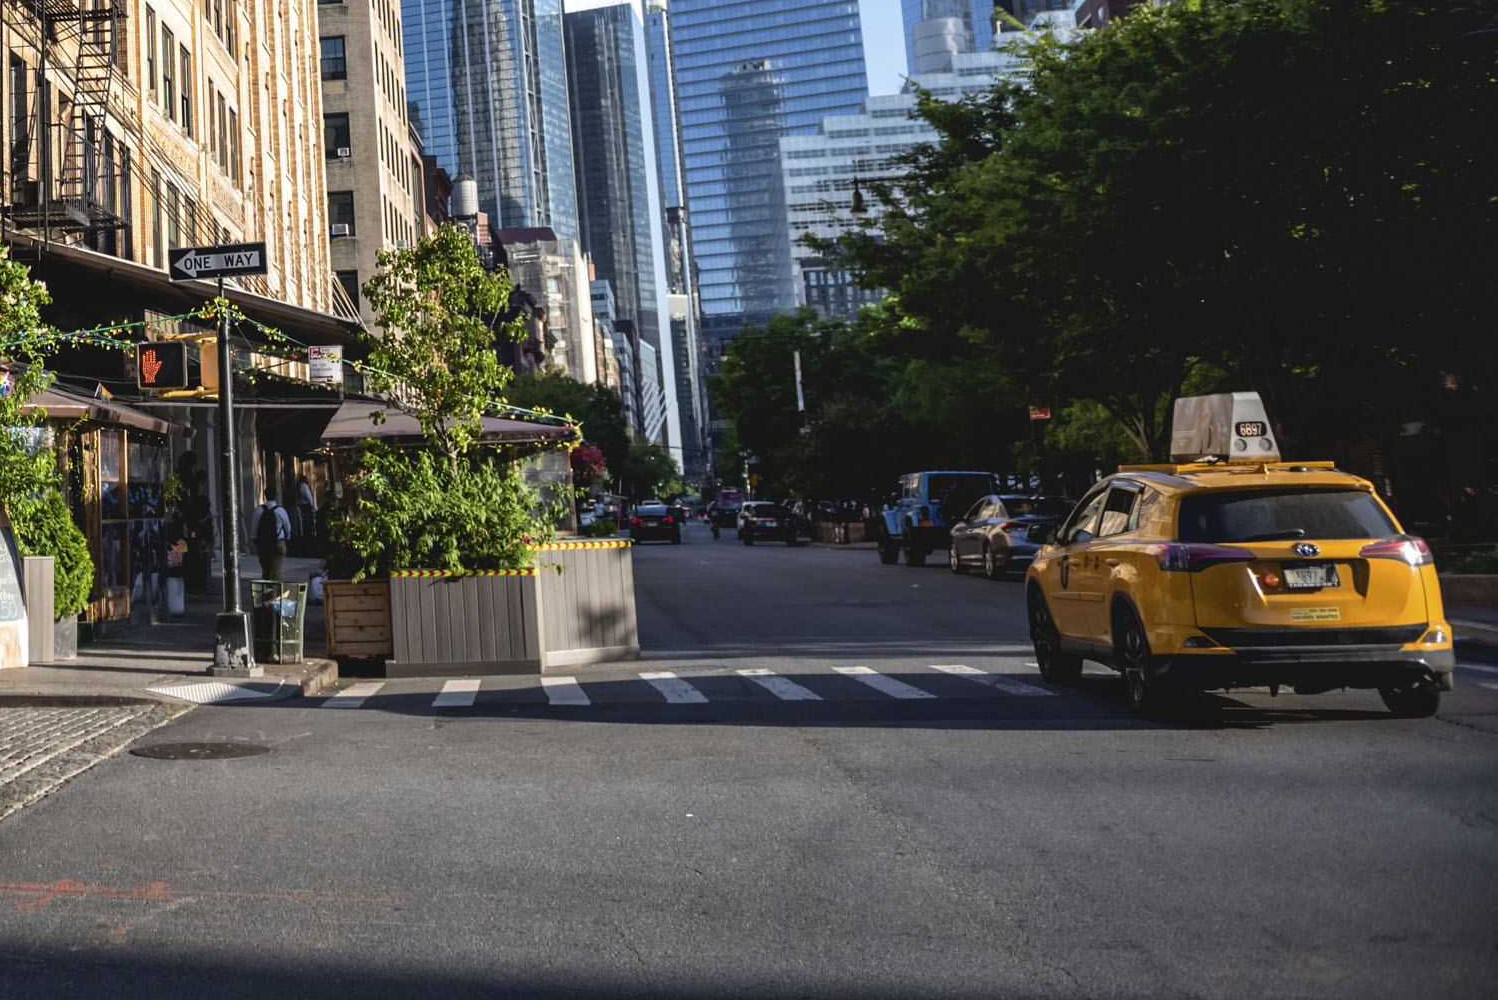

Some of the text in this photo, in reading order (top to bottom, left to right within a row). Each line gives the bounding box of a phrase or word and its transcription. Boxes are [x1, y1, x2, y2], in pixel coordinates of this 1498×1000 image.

[184, 252, 253, 270] ONE WAY
[1240, 423, 1262, 436] 6B97
